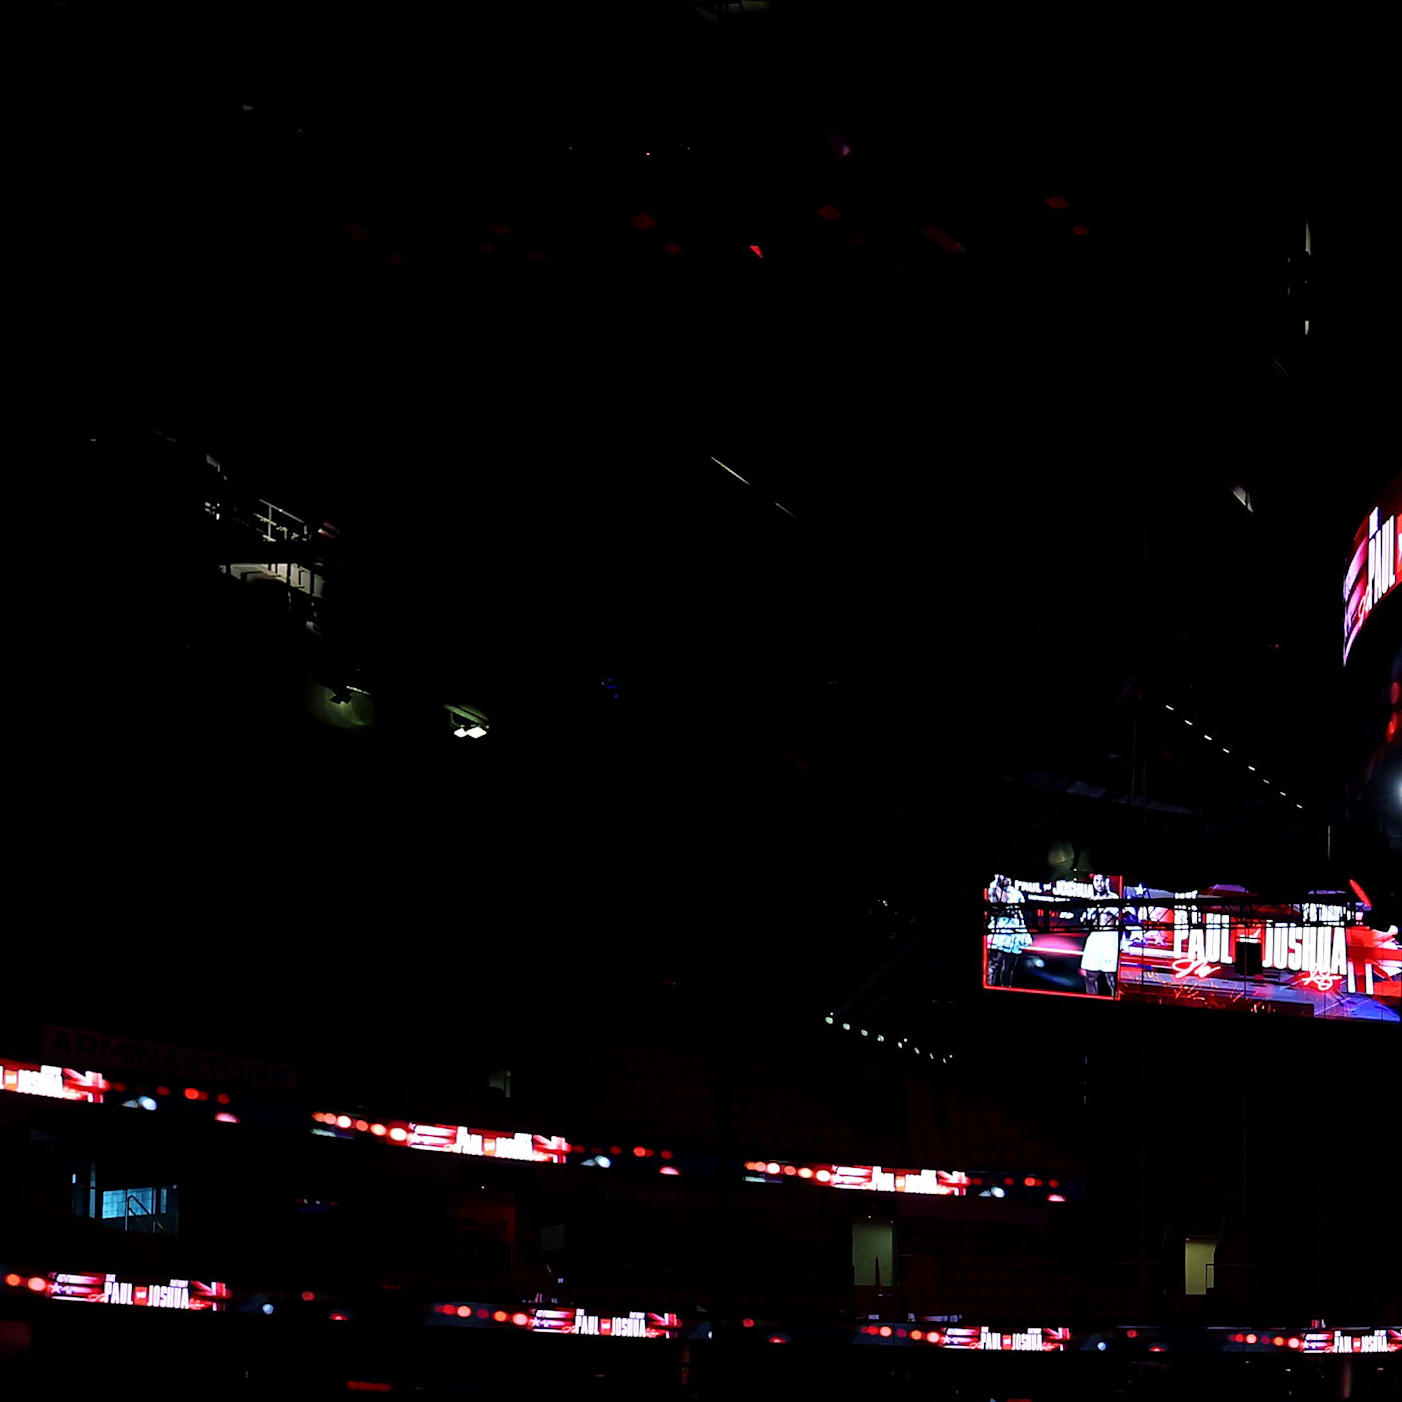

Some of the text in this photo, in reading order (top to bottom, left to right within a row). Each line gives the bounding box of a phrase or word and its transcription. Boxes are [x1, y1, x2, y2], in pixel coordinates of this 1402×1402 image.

[1367, 516, 1396, 611] PAUL
[104, 1281, 189, 1309] PAUL JOSHUA
[575, 1315, 646, 1337] PAUL JOSHUA
[980, 1332, 1002, 1350] PAUL
